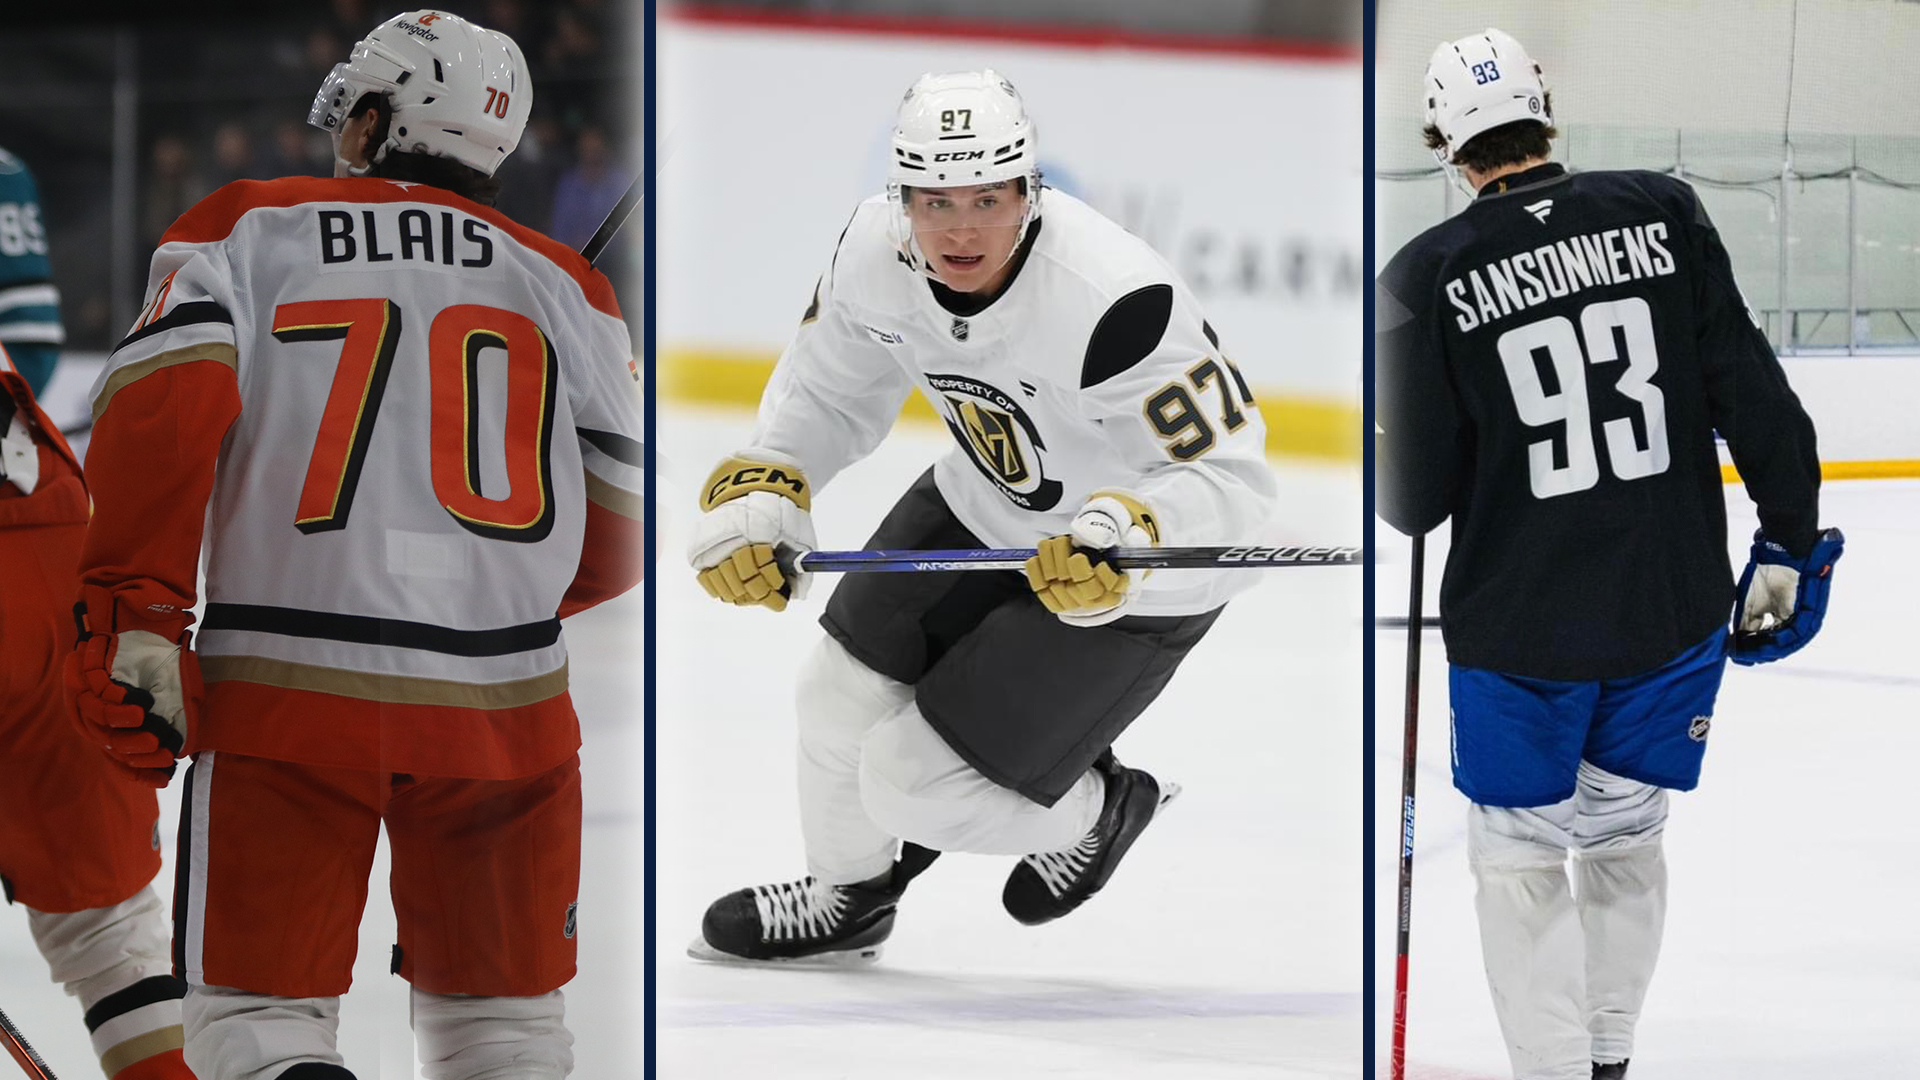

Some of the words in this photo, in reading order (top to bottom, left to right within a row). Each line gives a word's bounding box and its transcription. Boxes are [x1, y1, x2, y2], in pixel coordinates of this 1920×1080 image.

[393, 19, 439, 42] Navigator
[1471, 60, 1501, 86] 93
[483, 85, 510, 119] 70
[941, 109, 972, 132] 97
[934, 150, 986, 163] CCM
[317, 209, 494, 268] BLAIS
[1445, 221, 1676, 333] SANSONNENS
[930, 379, 992, 398] PROPERTY
[995, 396, 1016, 412] OF
[1142, 354, 1248, 462] 97
[1497, 296, 1672, 500] 93
[271, 297, 558, 544] 70
[707, 467, 804, 505] CCM
[1217, 546, 1362, 562] BAUER
